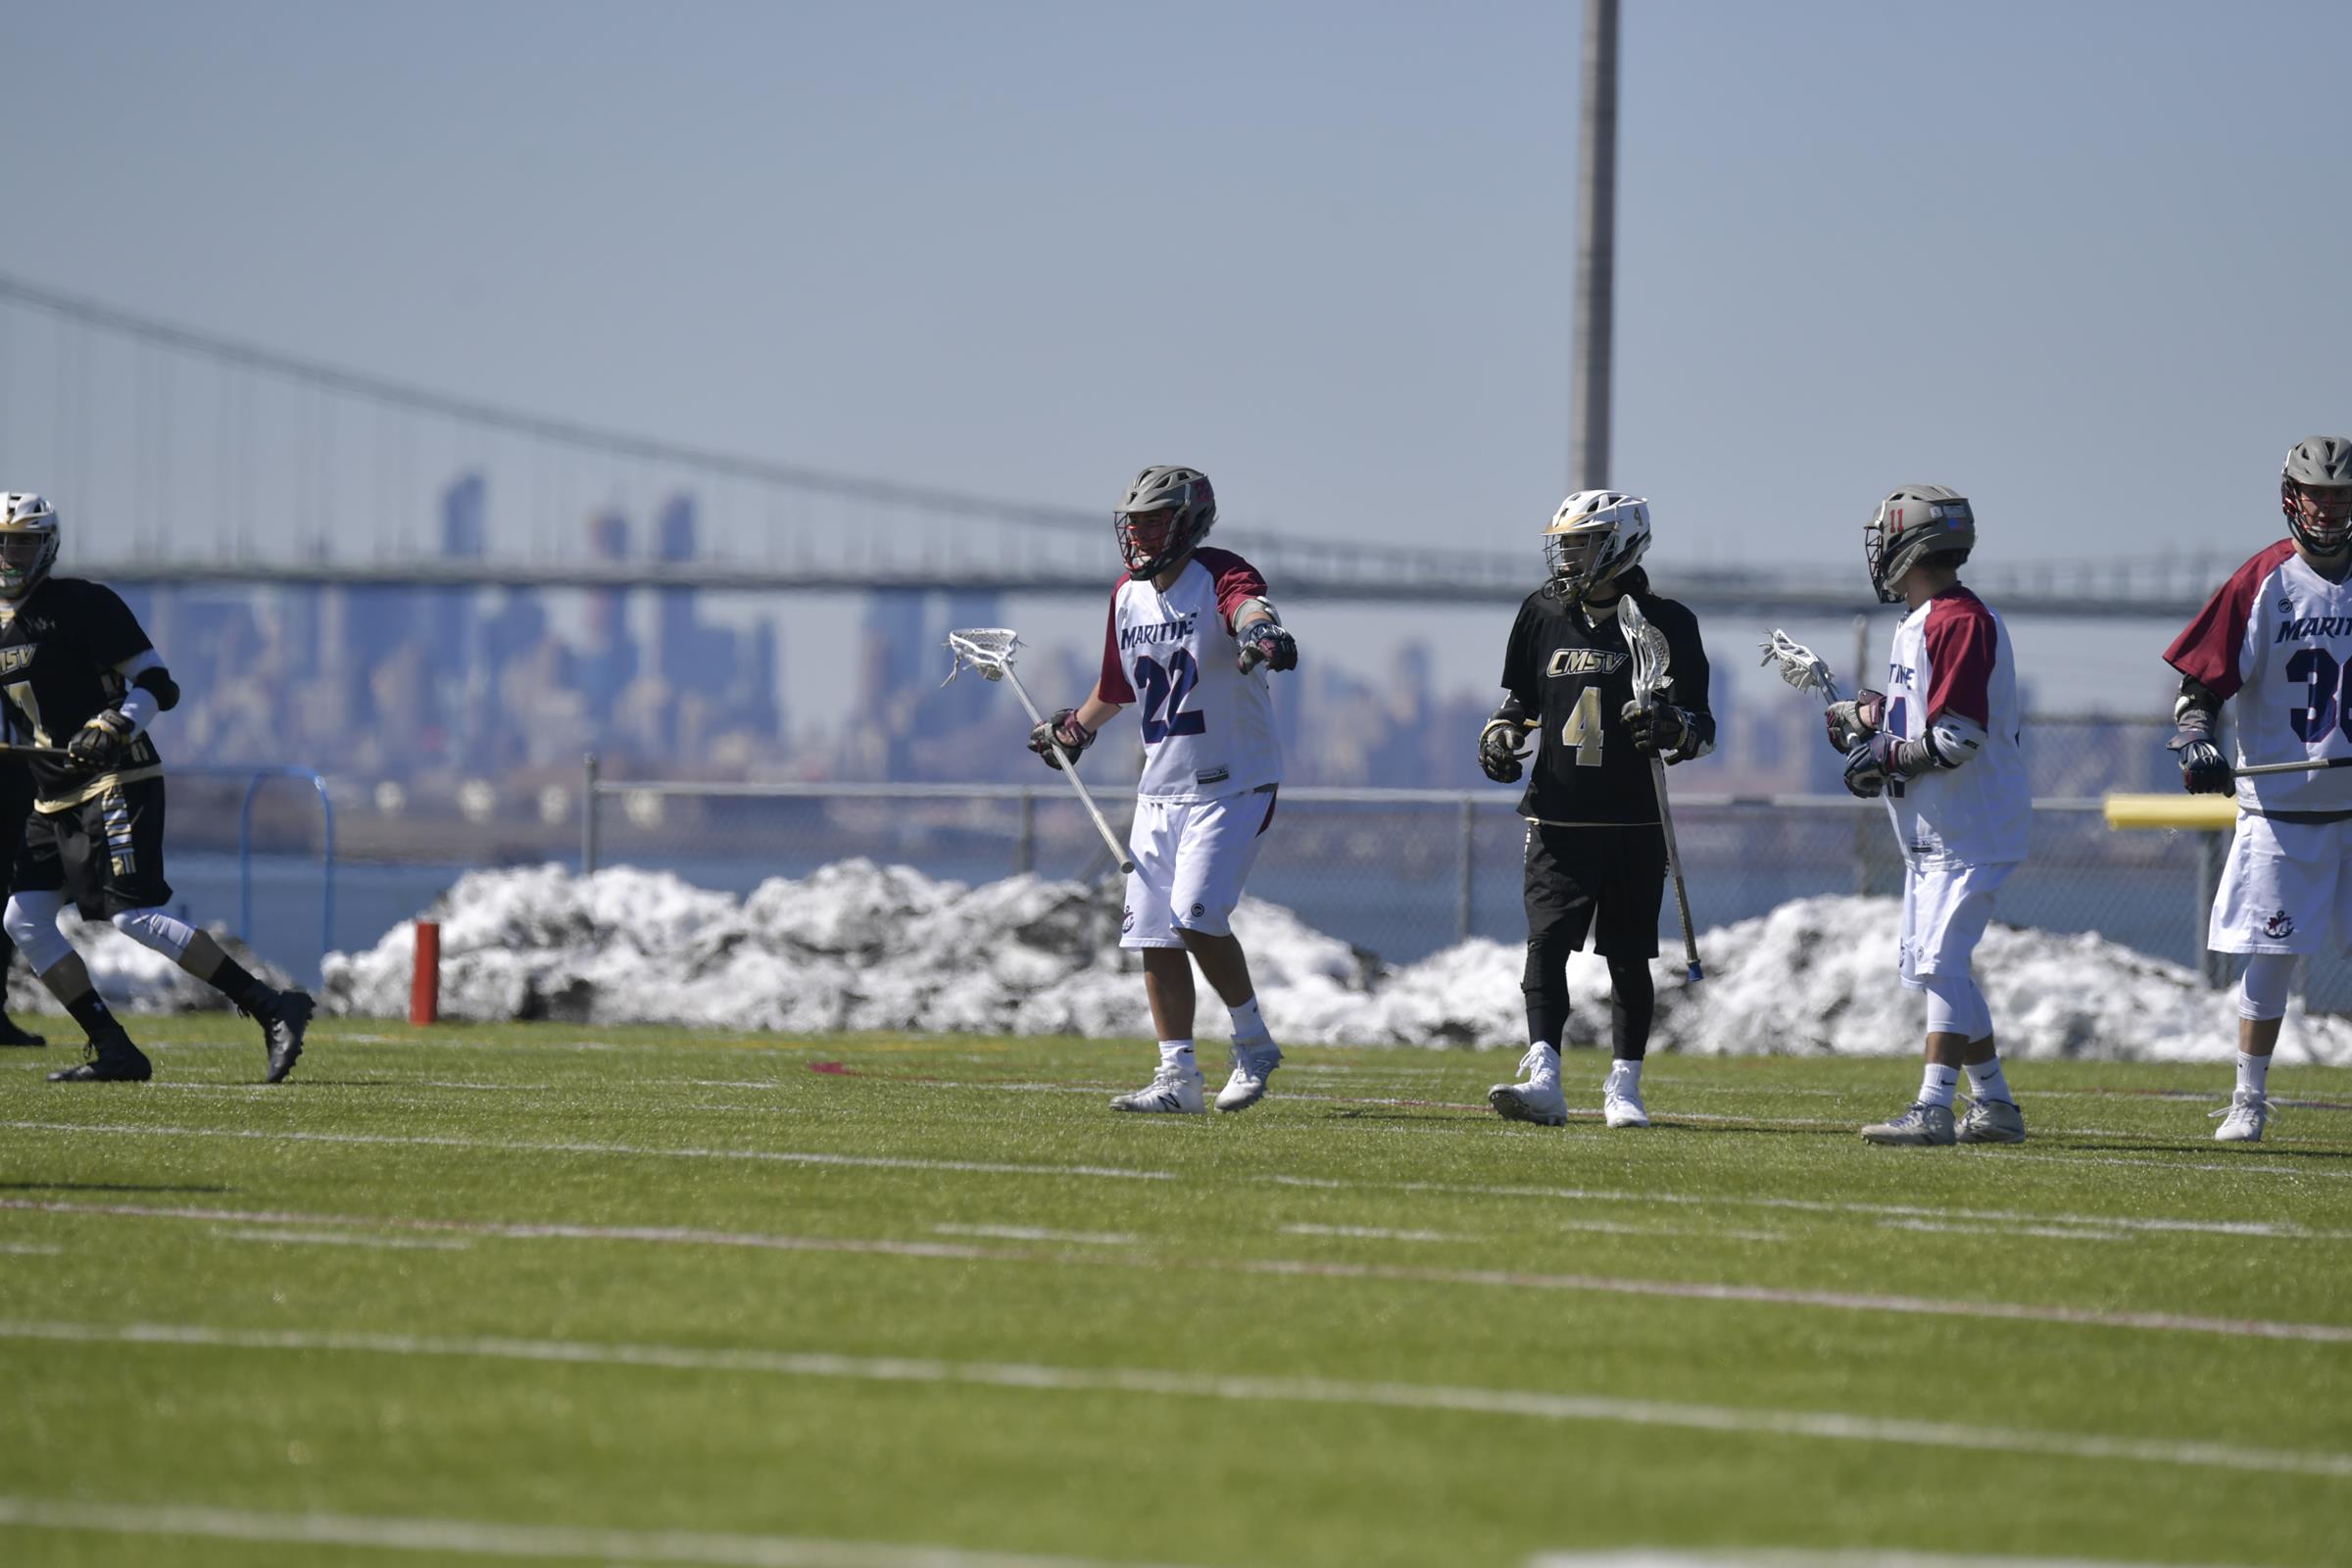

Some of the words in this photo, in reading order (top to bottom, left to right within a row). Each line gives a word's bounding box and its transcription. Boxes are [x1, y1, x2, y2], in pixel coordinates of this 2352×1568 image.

[1634, 507, 1643, 527] 4
[1889, 508, 1905, 534] 11
[1546, 648, 1628, 678] CMSV
[1134, 646, 1206, 745] 22
[2285, 648, 2352, 745] 3
[1562, 685, 1604, 767] 4
